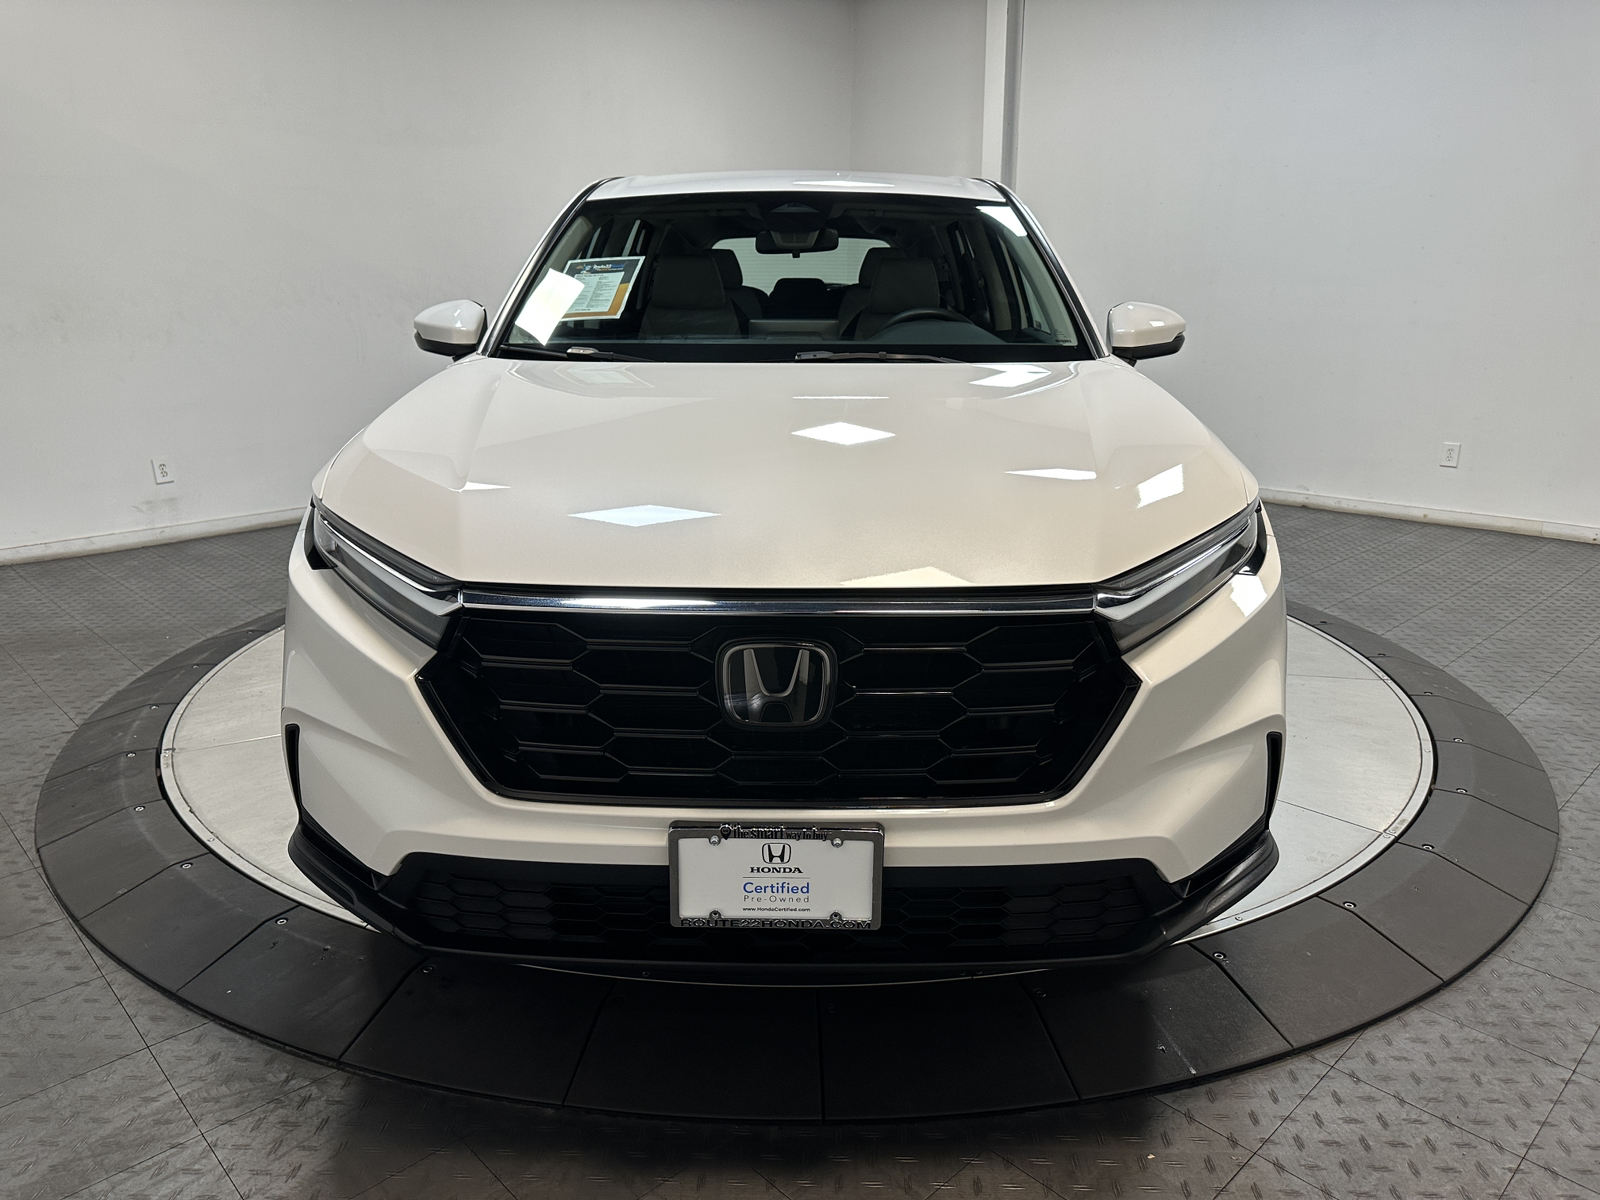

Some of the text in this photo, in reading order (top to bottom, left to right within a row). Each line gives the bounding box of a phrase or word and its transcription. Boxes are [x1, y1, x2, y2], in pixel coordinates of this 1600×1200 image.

[733, 823, 749, 838] the
[750, 824, 784, 839] smart
[786, 830, 801, 841] way
[813, 826, 828, 841] buy
[743, 882, 810, 894] Certified
[743, 895, 810, 903] Pre-Owned
[680, 918, 872, 929] ROUTE22HONDA.COM
